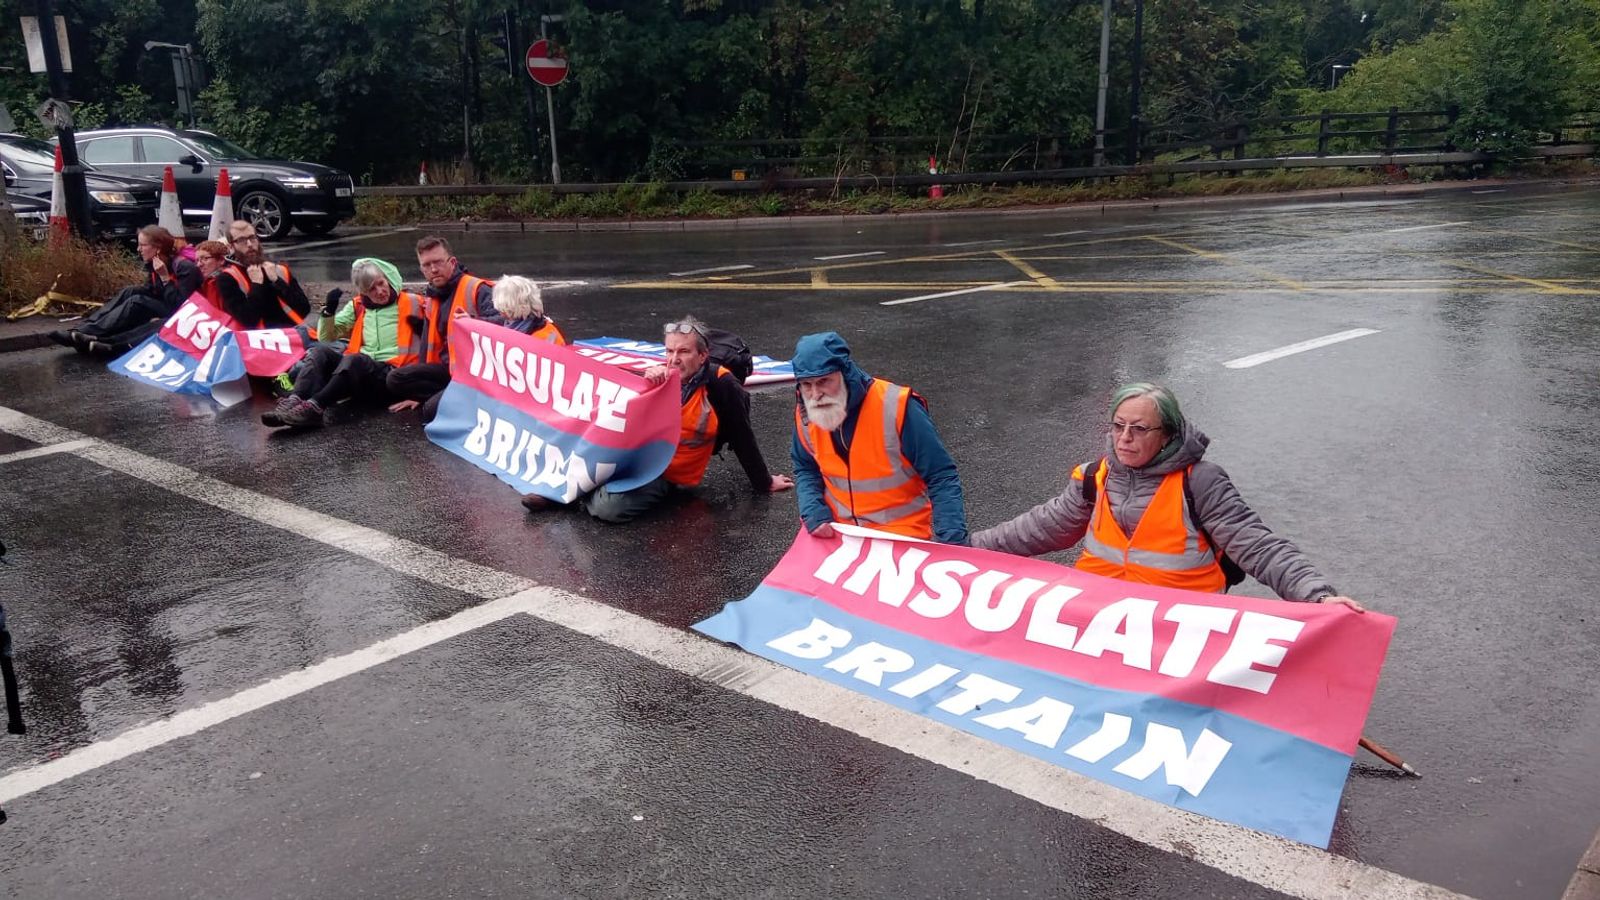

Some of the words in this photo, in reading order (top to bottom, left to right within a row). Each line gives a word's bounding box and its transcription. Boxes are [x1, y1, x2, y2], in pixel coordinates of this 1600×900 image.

[470, 332, 640, 433] INSULATE
[464, 408, 616, 504] BRITAN
[813, 534, 1305, 694] INSULATE
[767, 619, 1232, 796] BRITAIN
